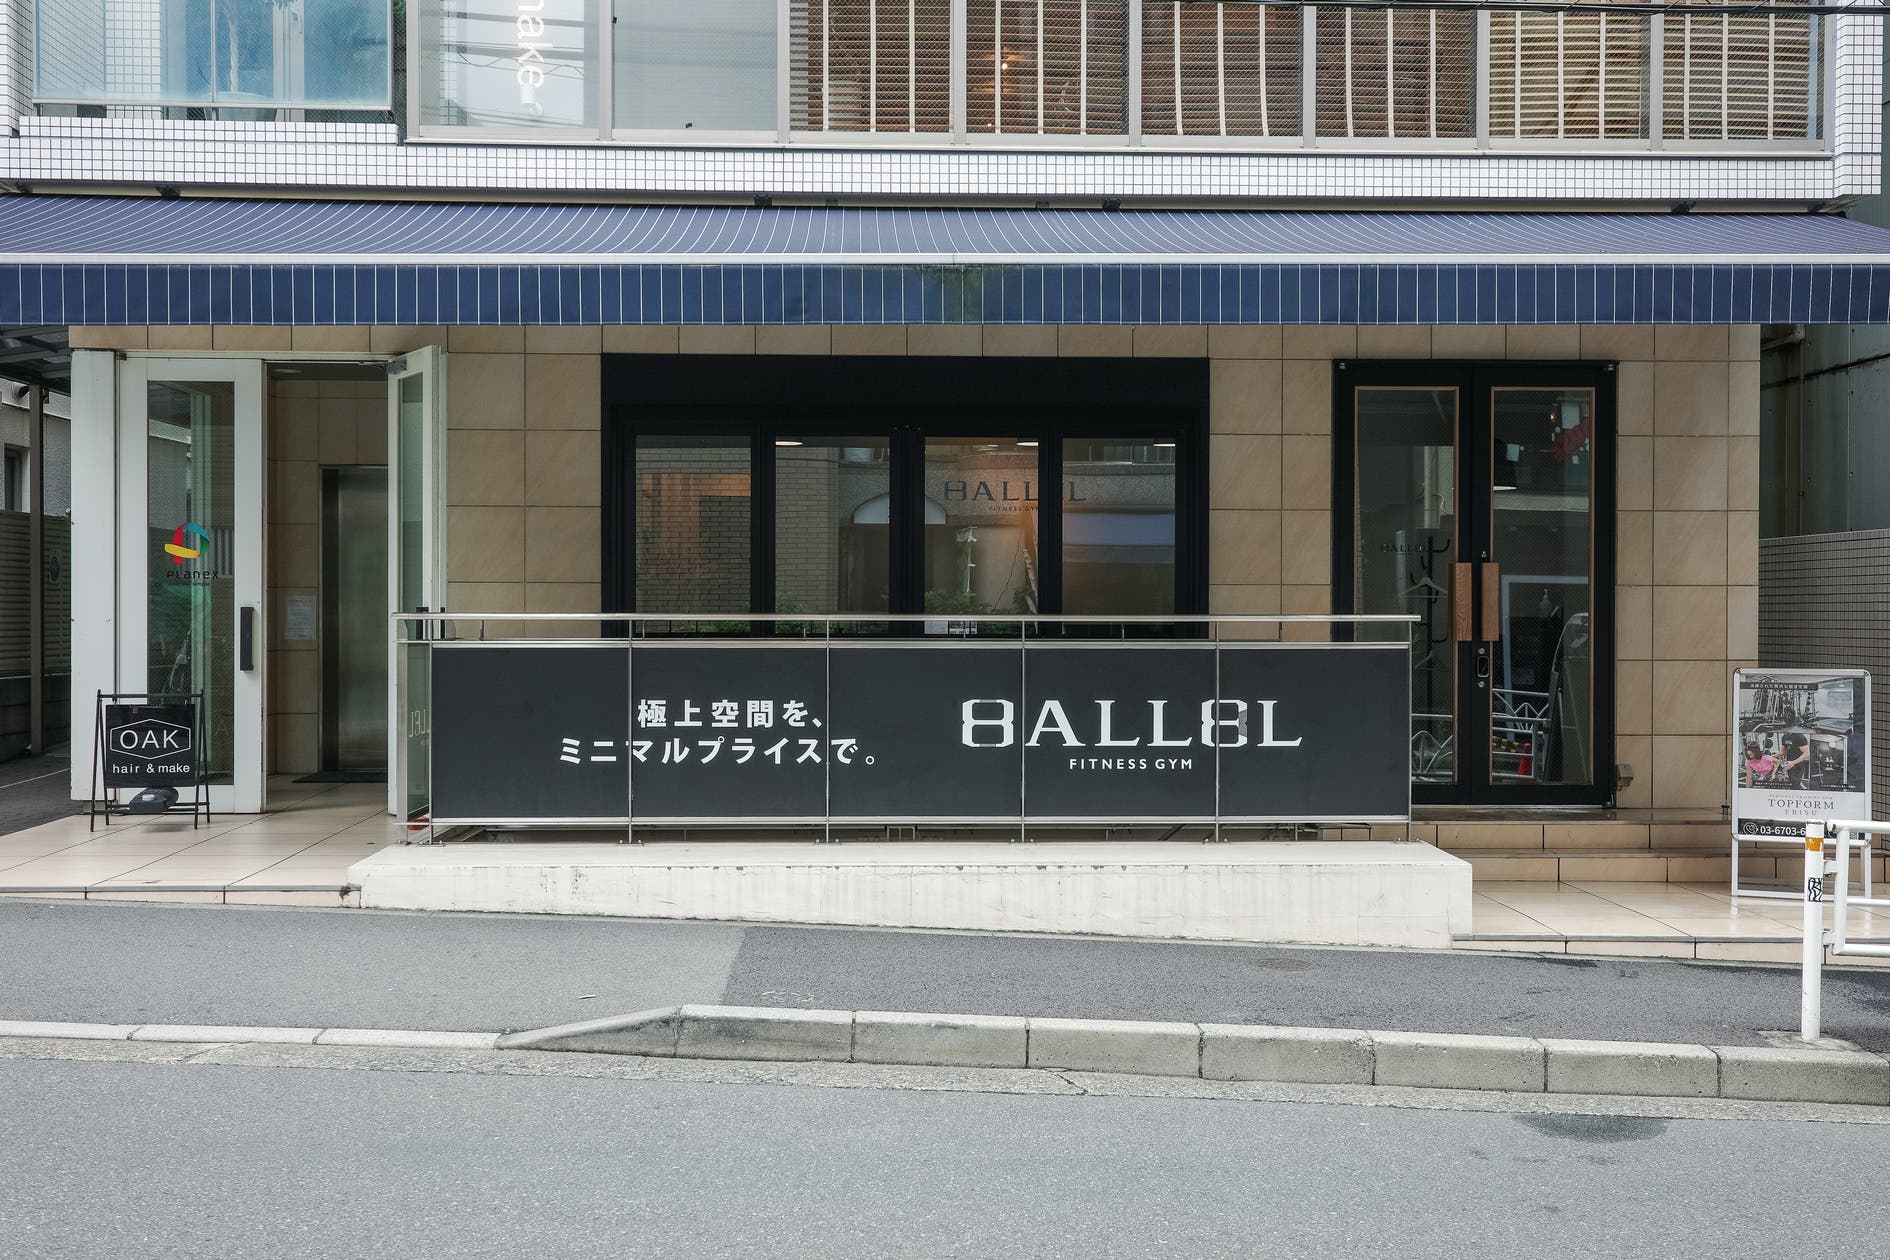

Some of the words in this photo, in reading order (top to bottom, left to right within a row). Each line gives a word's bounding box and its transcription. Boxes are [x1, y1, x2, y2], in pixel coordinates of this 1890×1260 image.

[637, 699, 823, 728] 極上空間を、
[120, 730, 179, 749] OAK
[560, 737, 875, 765] ミニマルプライスで。
[112, 763, 140, 774] hair
[146, 763, 155, 773] &
[158, 763, 190, 773] make
[1070, 758, 1148, 770] FITNESS
[1155, 758, 1193, 770] GYM
[1768, 799, 1835, 810] TOPFORM
[1760, 825, 1806, 836] 03-6703-6
